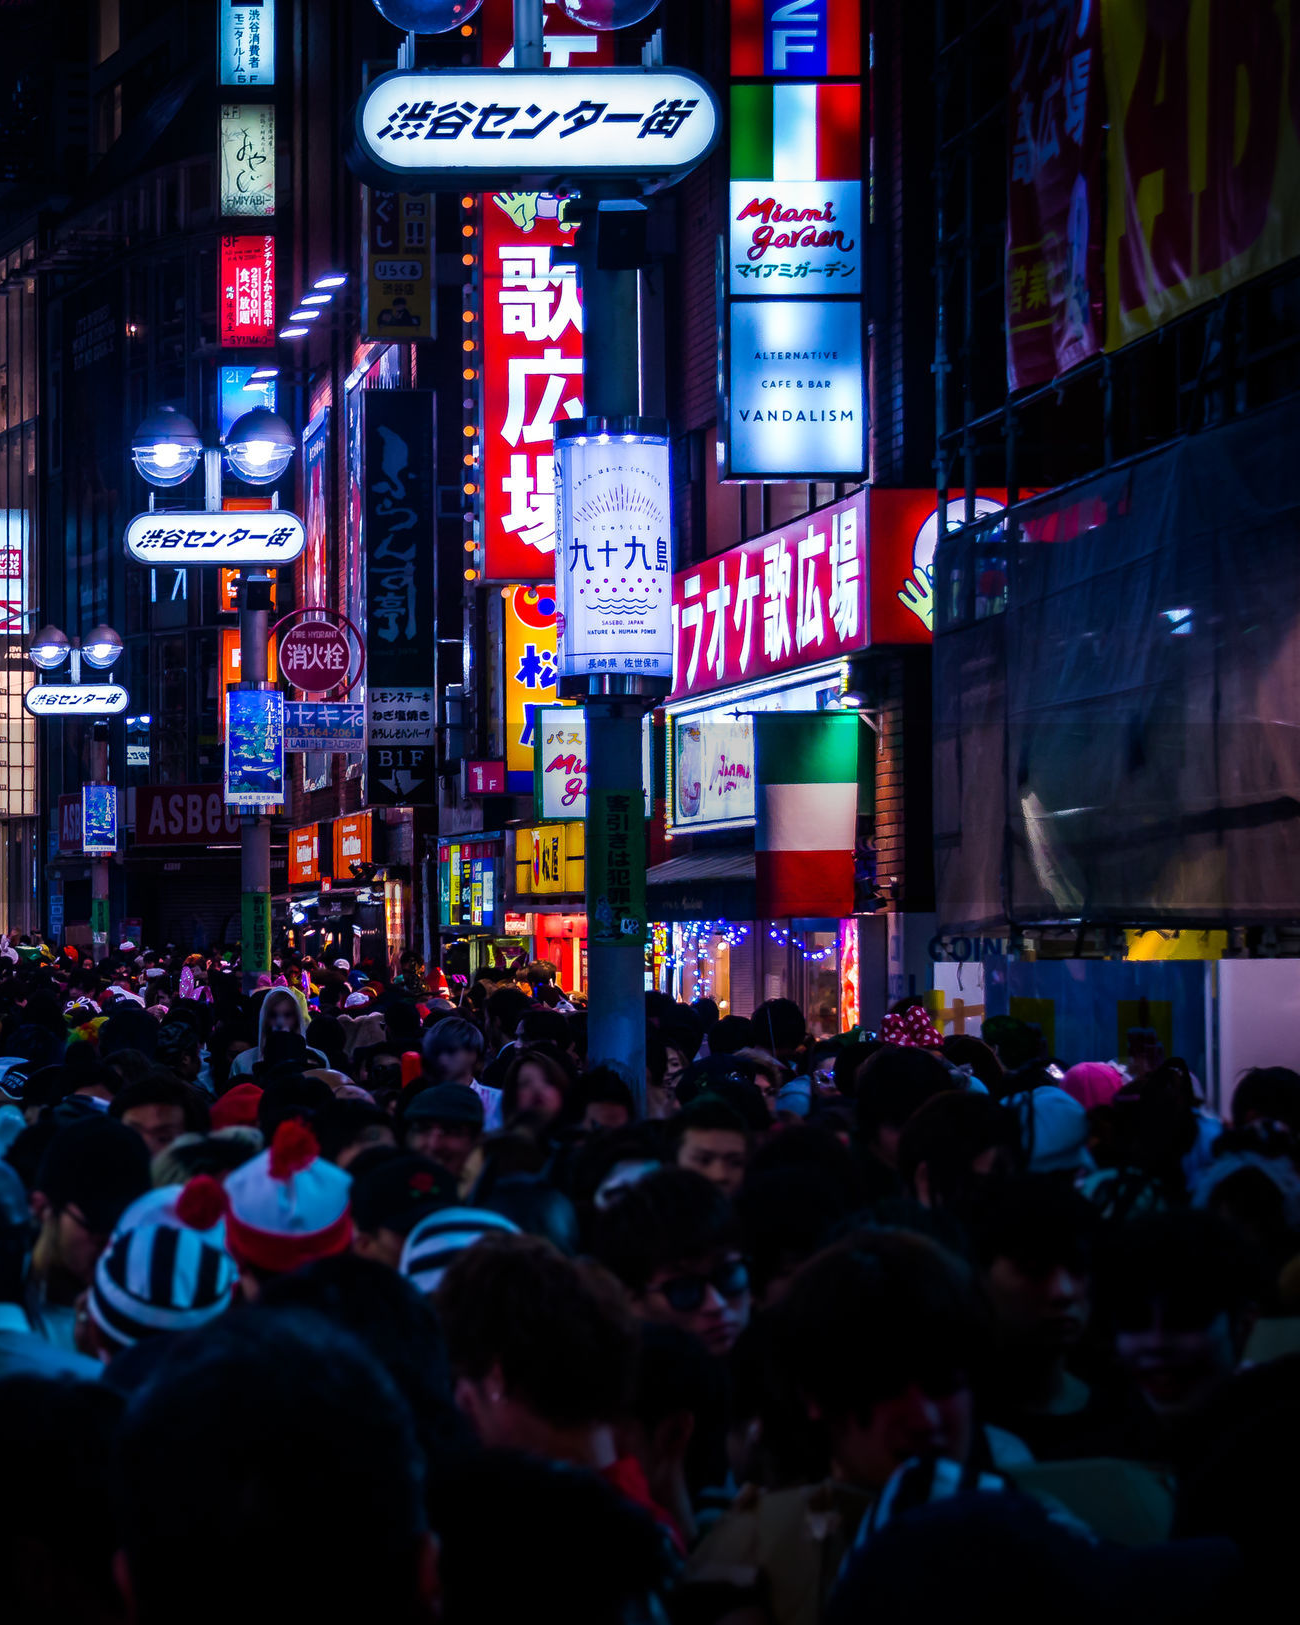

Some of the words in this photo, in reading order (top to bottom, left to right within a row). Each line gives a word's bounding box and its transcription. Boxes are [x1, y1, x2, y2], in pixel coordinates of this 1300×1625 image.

[234, 14, 245, 72] モニタールーム
[377, 99, 700, 141] 渋谷センター街
[736, 198, 837, 223] Miami
[735, 262, 856, 278] マイアミガーデン
[754, 352, 839, 360] ALTERNATIVE
[761, 380, 791, 388] CAFE
[797, 380, 803, 388] &
[808, 380, 831, 388] BAR
[739, 410, 854, 422] VANDALISM
[135, 527, 298, 549] 渋谷センター街
[569, 535, 669, 573] 九十九島
[292, 631, 306, 639] FIRE
[308, 630, 338, 639] HYDRANT
[287, 643, 345, 670] 消火栓
[588, 658, 618, 669] 長崎県
[624, 658, 659, 668] 佐世保市
[371, 692, 431, 703] レモンステーキ
[294, 705, 364, 728] セキネ
[285, 728, 356, 737] 03-3464-2061
[547, 731, 584, 745] パス
[378, 750, 426, 767] B1F
[63, 803, 81, 841] ASB
[928, 935, 1002, 962] COIN
